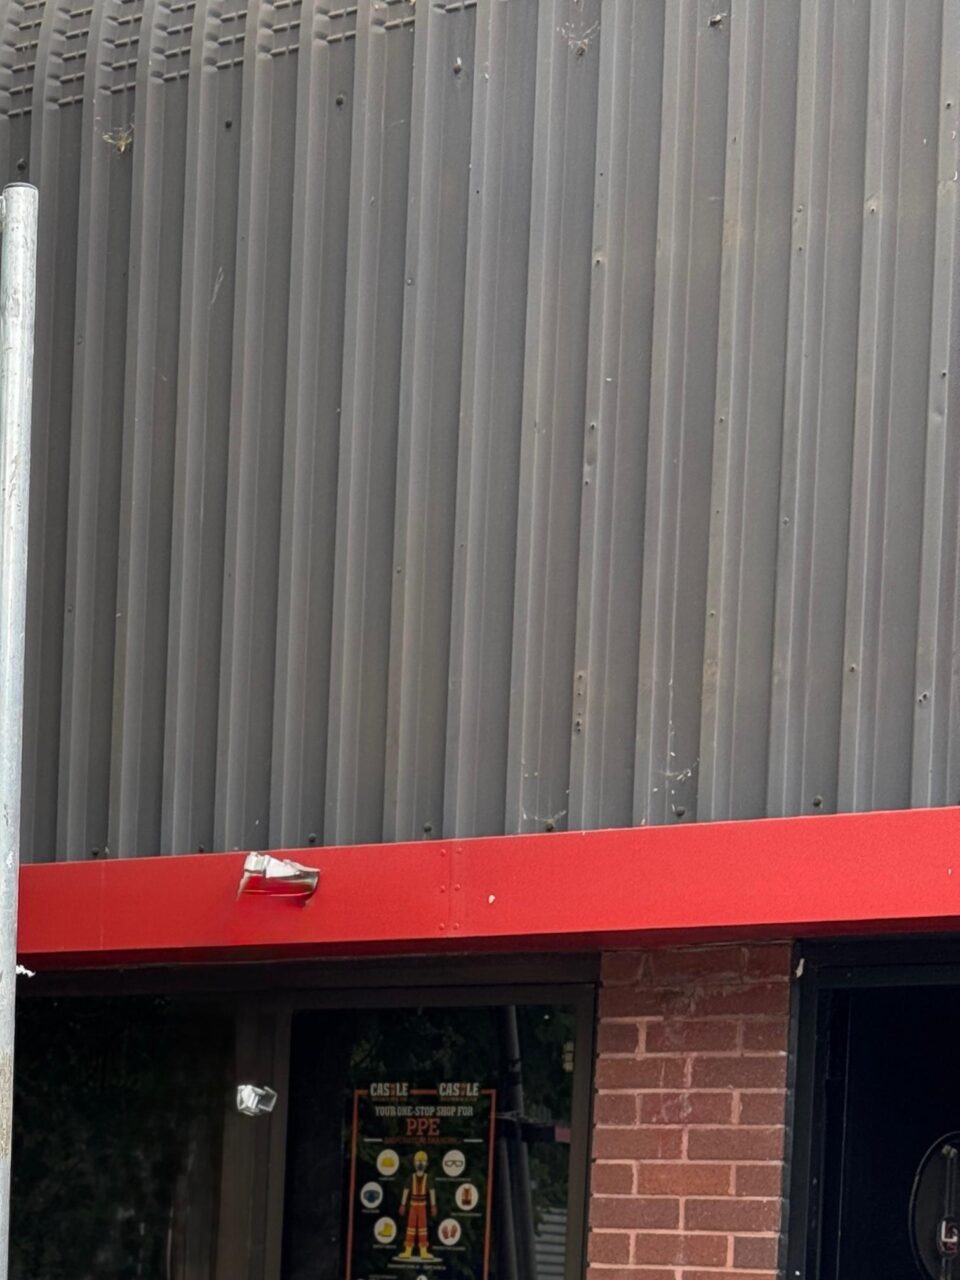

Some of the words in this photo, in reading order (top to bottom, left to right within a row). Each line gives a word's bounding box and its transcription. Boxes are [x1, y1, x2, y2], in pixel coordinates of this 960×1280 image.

[375, 1105, 396, 1117] YOUR
[397, 1105, 436, 1117] ONE-STOP
[436, 1105, 456, 1117] SHOP
[457, 1105, 474, 1117] FOR
[405, 1117, 441, 1136] PPE
